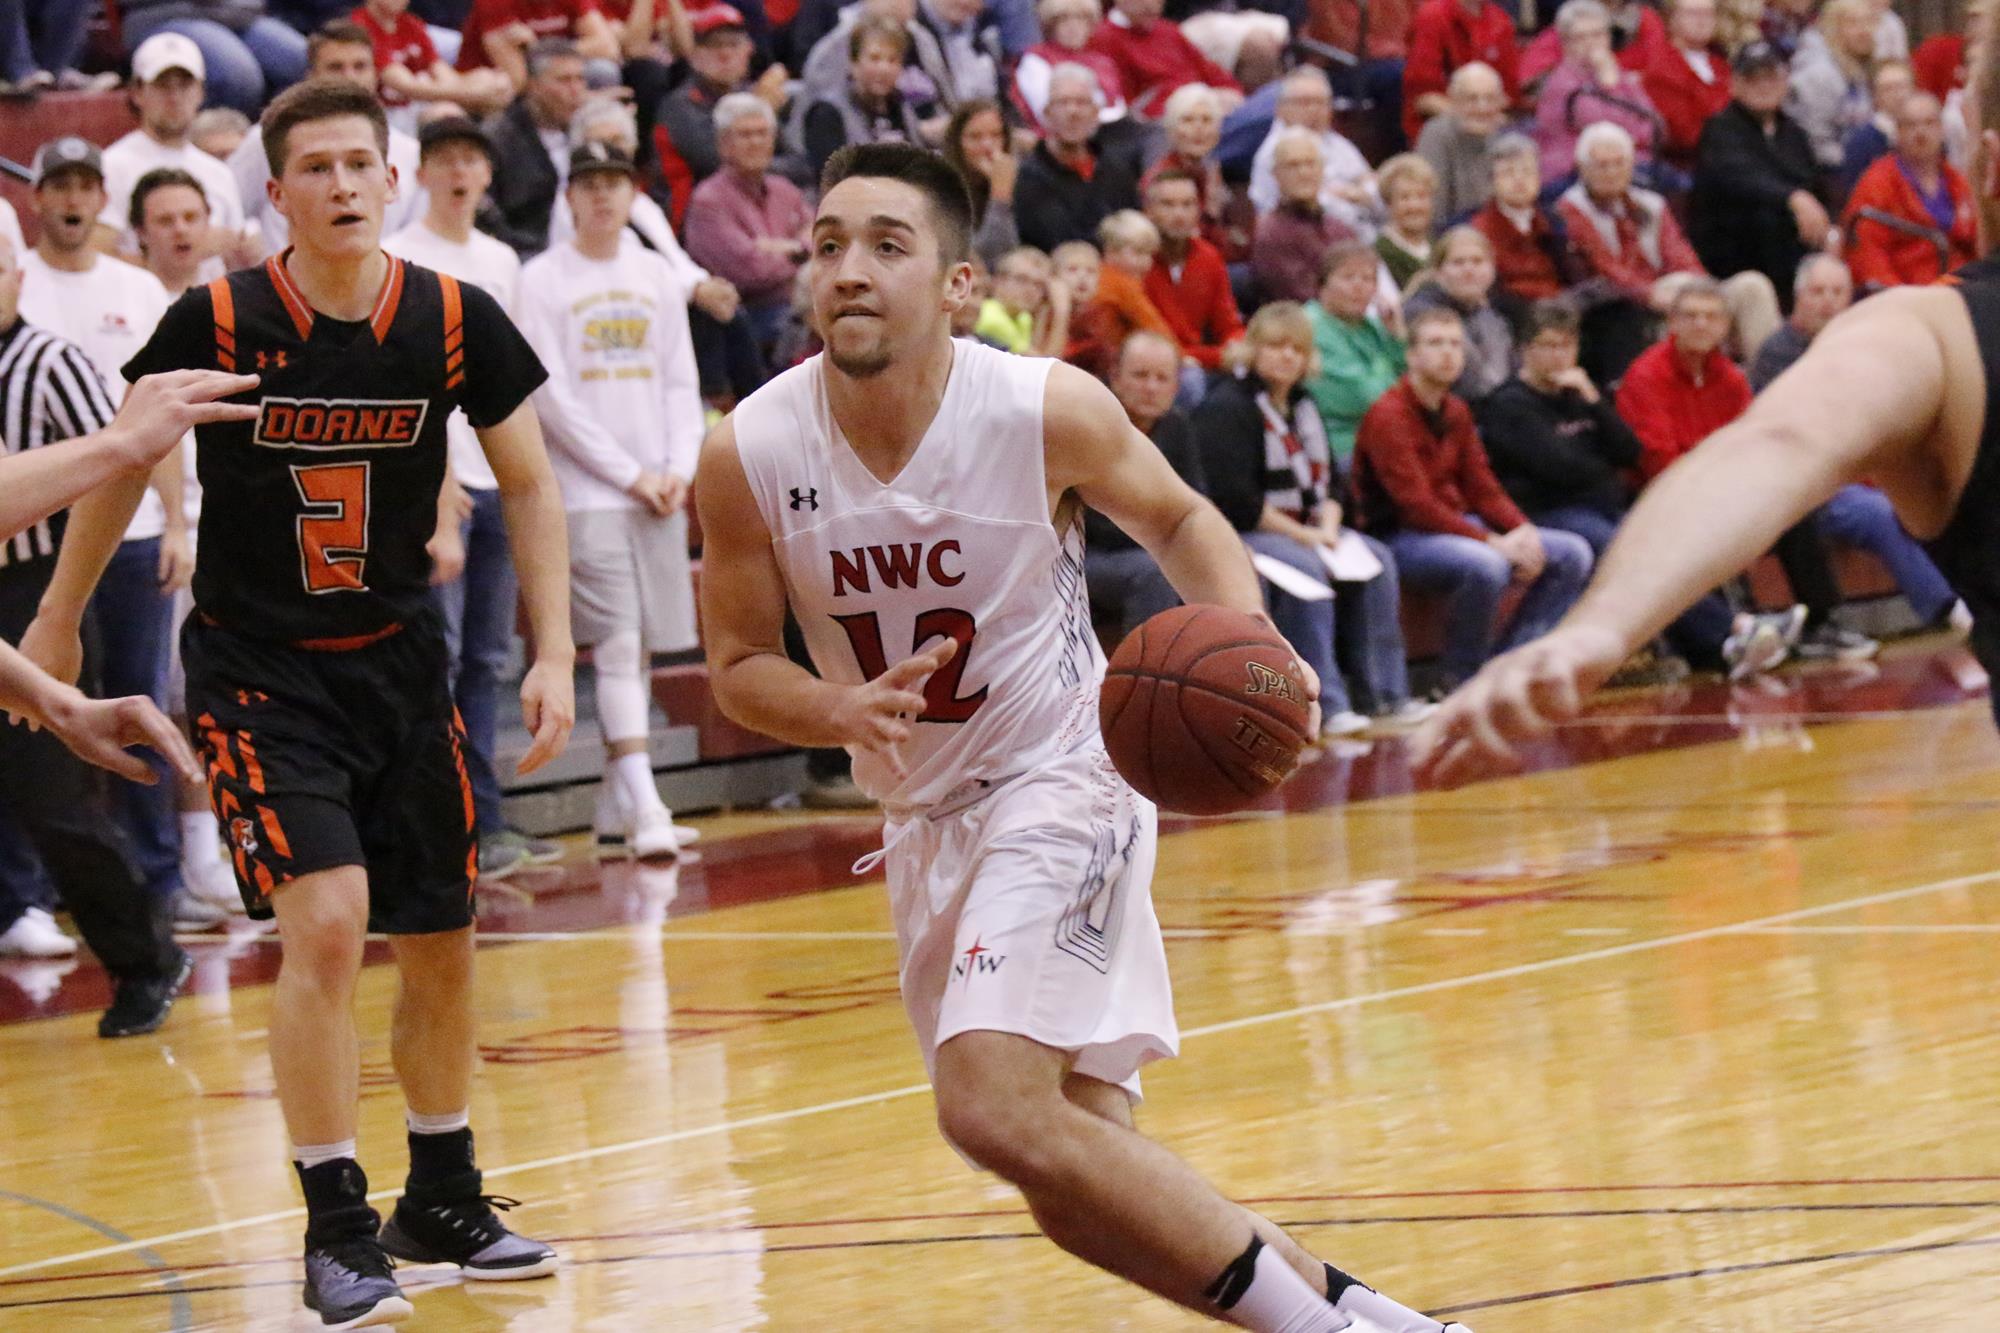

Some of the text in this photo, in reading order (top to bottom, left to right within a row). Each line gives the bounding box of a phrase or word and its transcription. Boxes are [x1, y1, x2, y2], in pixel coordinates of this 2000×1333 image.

[263, 406, 417, 442] DOANE
[289, 461, 371, 595] 2
[829, 539, 966, 597] NWC
[827, 607, 990, 723] 12
